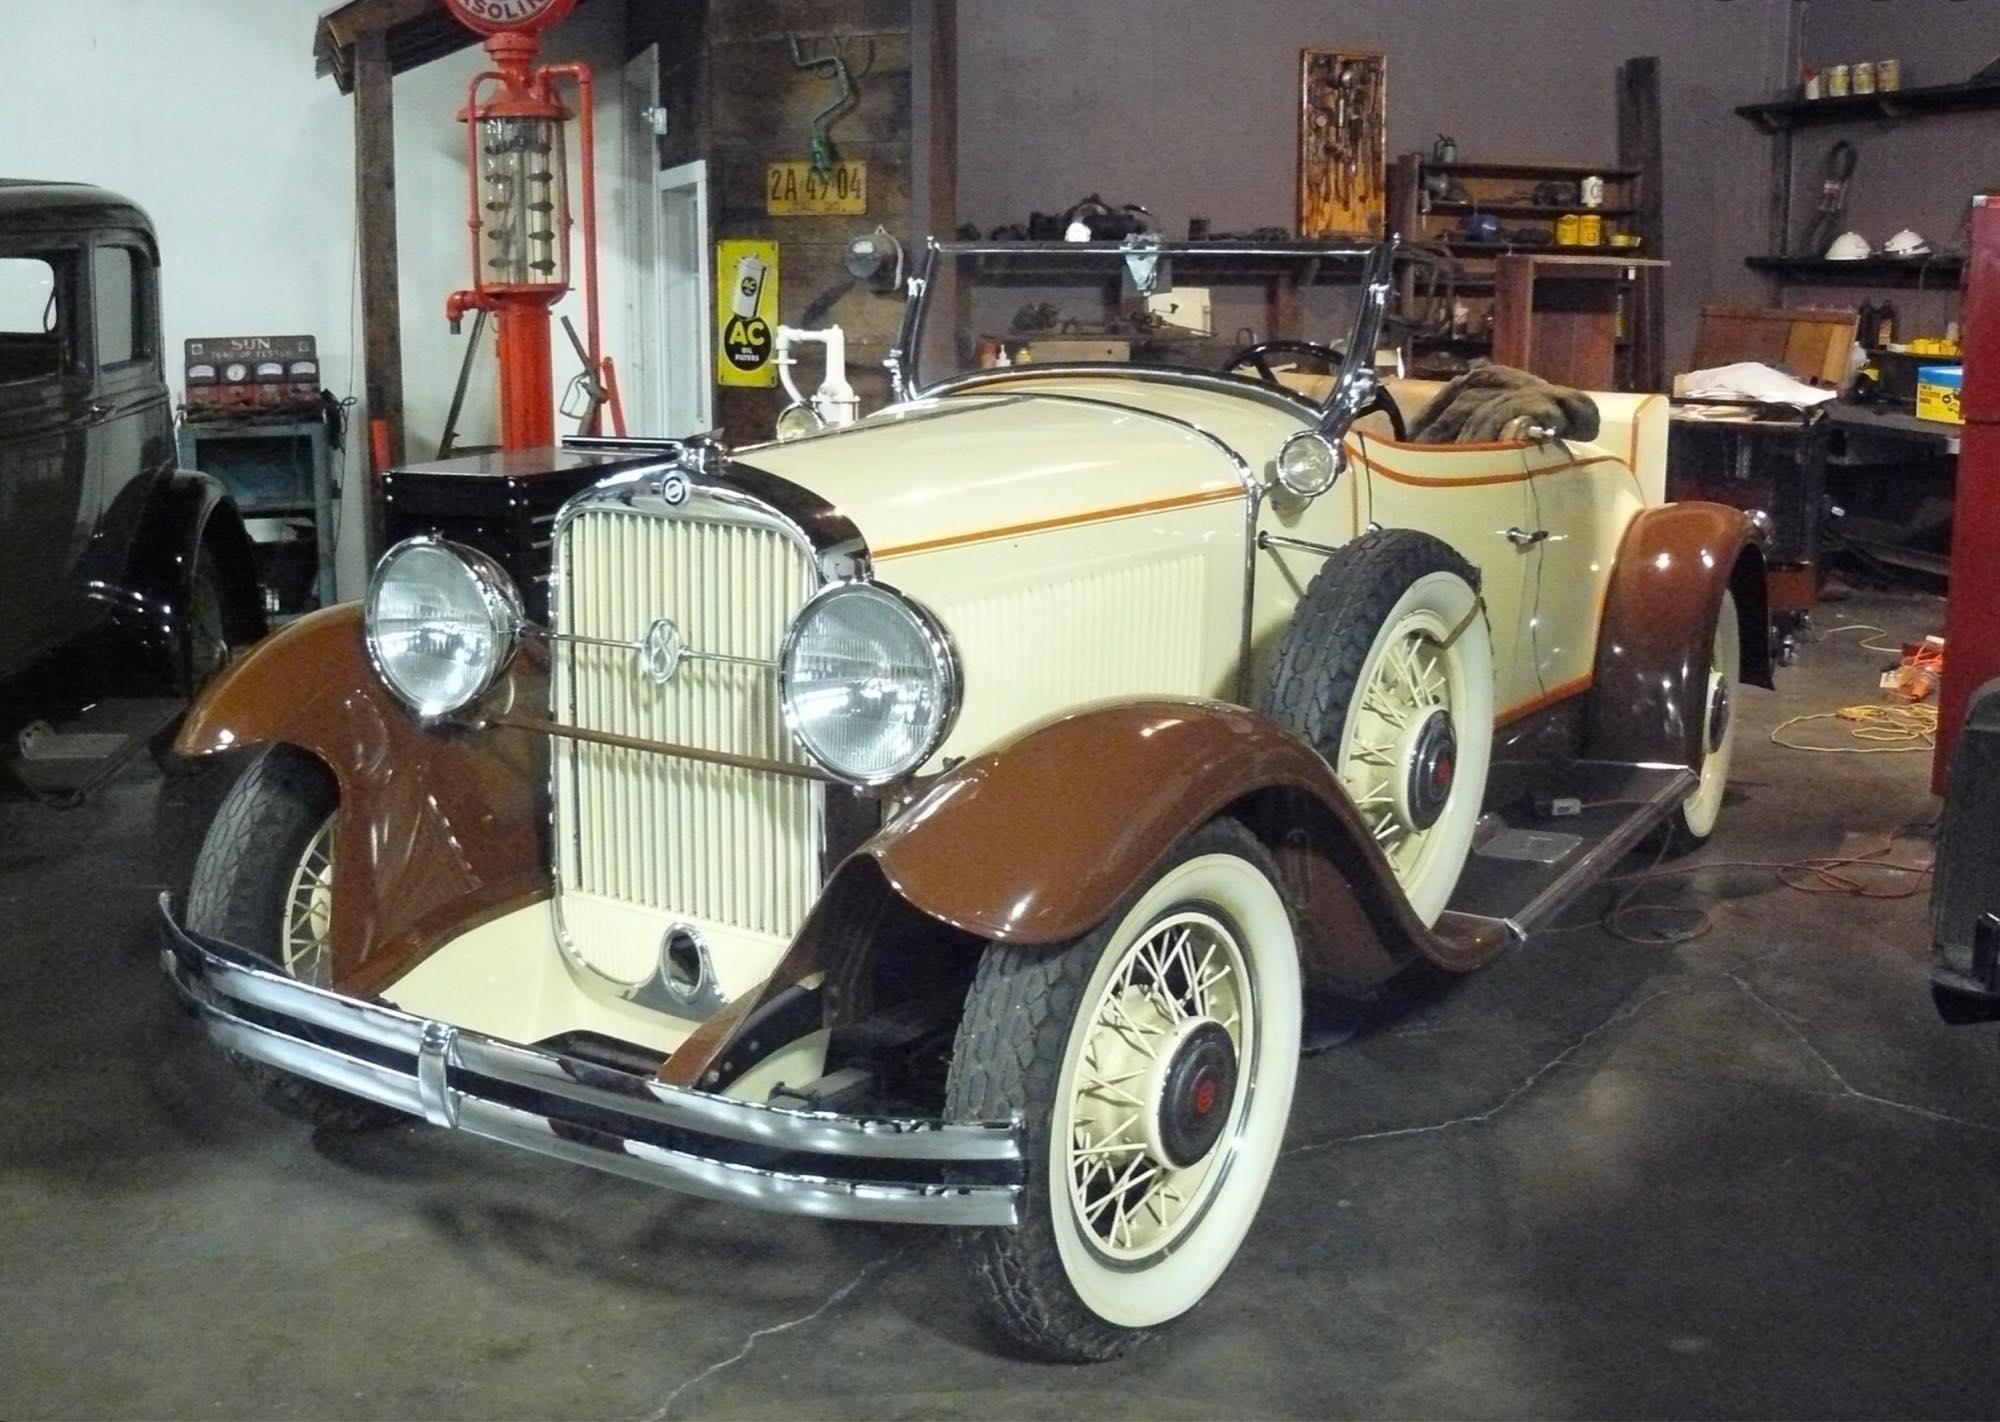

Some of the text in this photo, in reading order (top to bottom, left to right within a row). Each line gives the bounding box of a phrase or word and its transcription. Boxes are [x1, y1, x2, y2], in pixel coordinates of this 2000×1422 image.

[465, 0, 544, 19] SOLI
[771, 166, 797, 201] 2A
[837, 166, 861, 201] 04
[729, 321, 765, 346] AC
[231, 338, 271, 351] SUN
[735, 354, 760, 362] FILTERS
